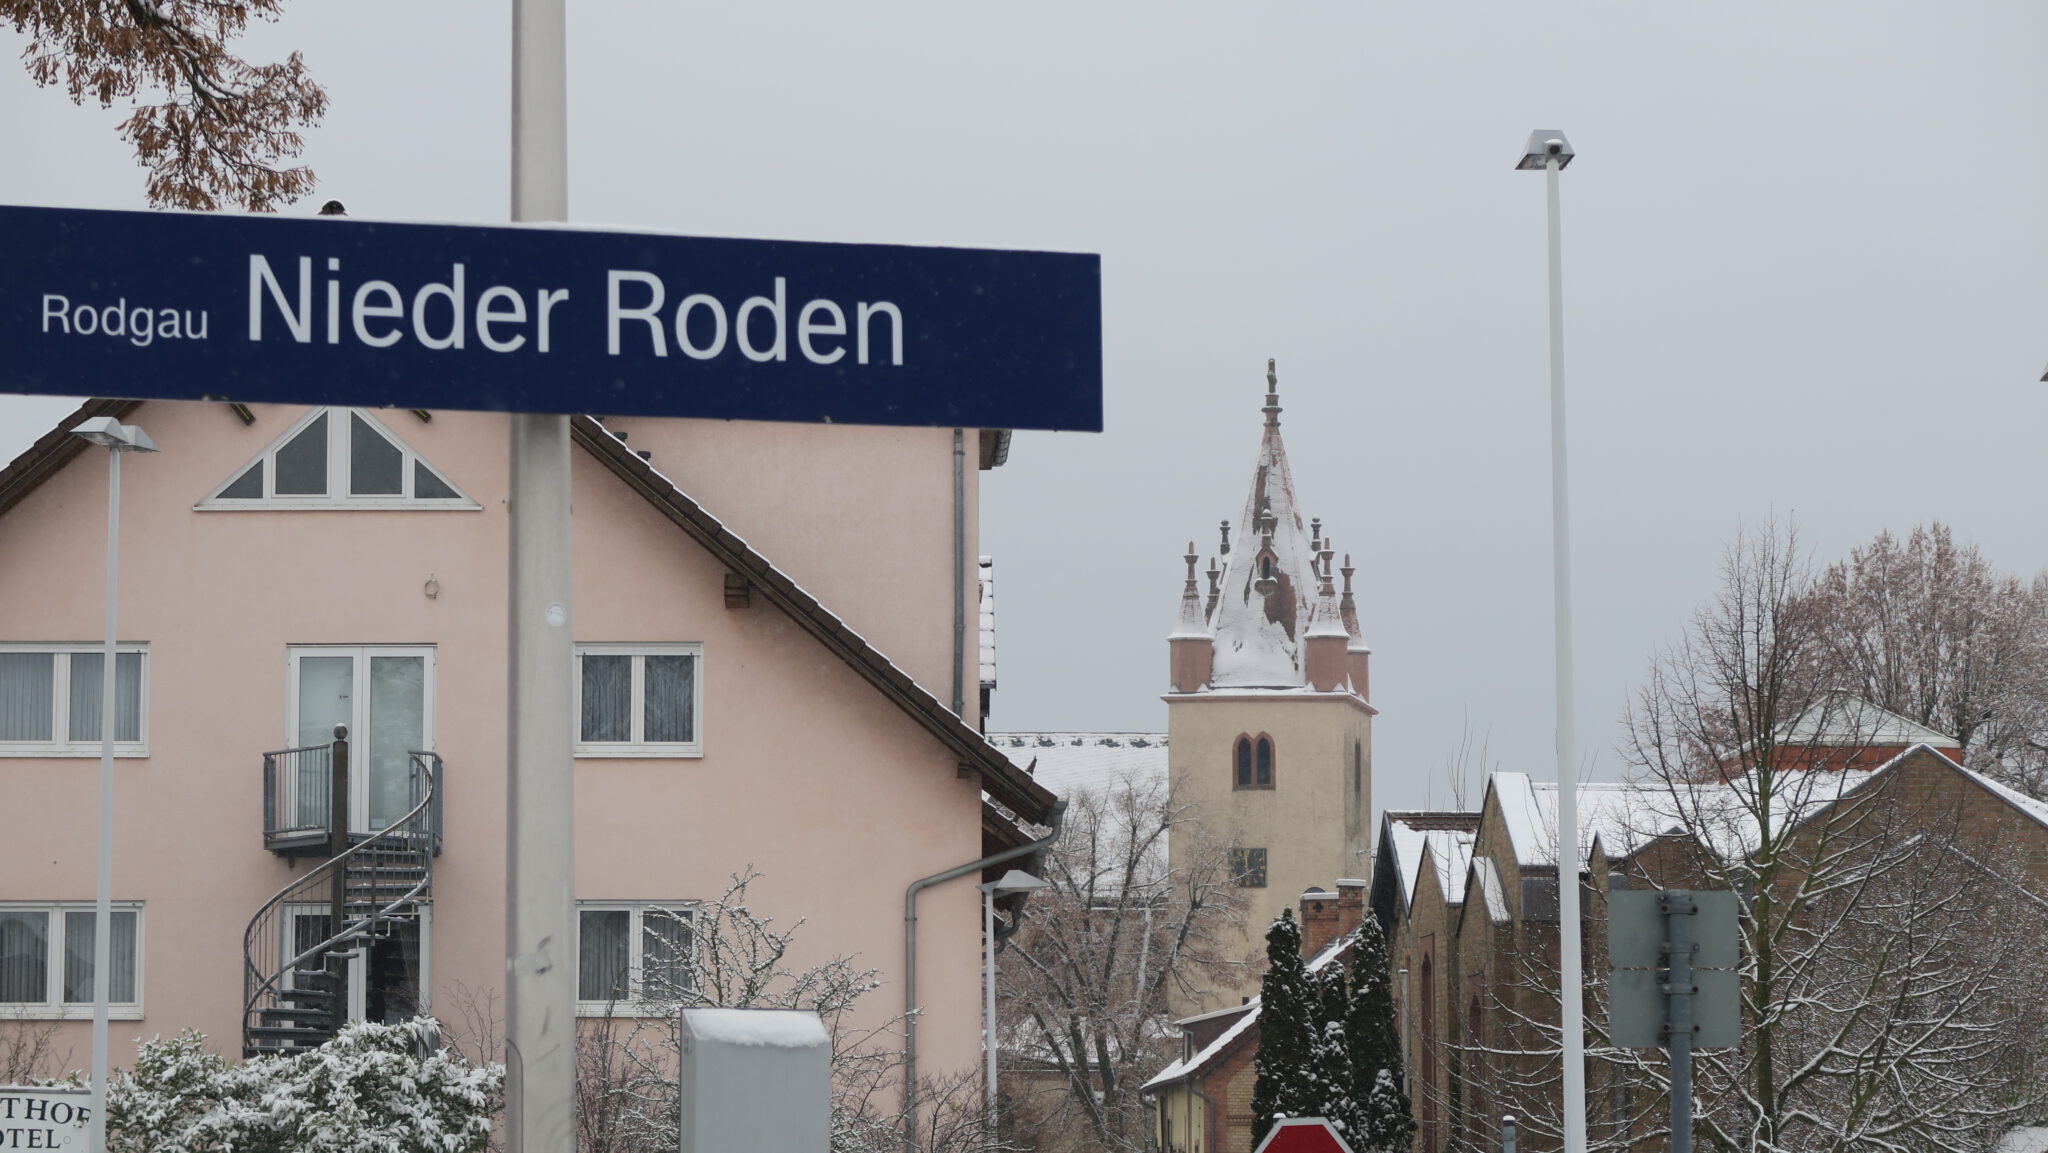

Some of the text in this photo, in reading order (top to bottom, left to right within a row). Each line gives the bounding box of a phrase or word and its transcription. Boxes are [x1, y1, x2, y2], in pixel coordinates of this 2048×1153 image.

[42, 254, 904, 366] Rodgau Nieder Roden
[0, 1128, 61, 1149] TEL
